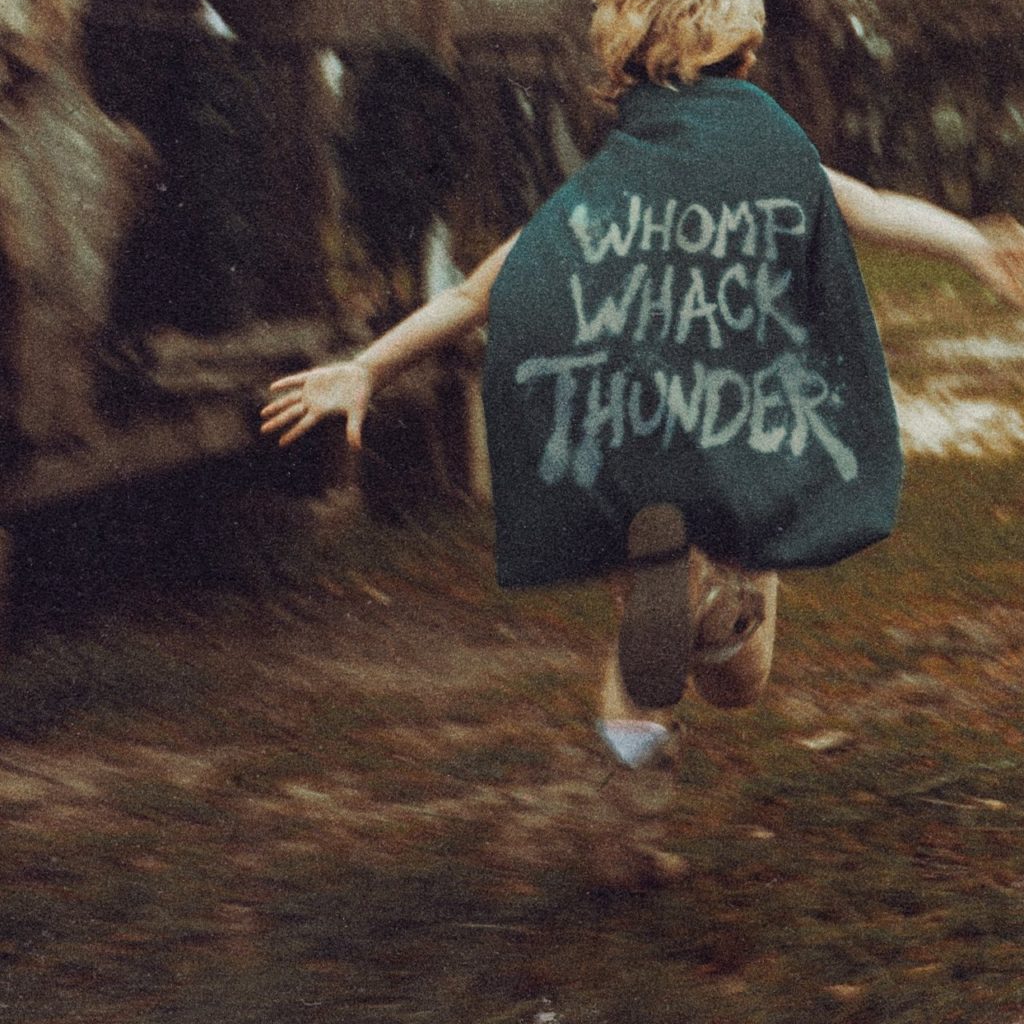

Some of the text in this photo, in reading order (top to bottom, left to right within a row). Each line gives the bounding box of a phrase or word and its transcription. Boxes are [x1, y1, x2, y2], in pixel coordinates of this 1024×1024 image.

[568, 194, 806, 264] WHOMP
[570, 262, 808, 348] WHACK
[515, 351, 859, 487] THUNDER
